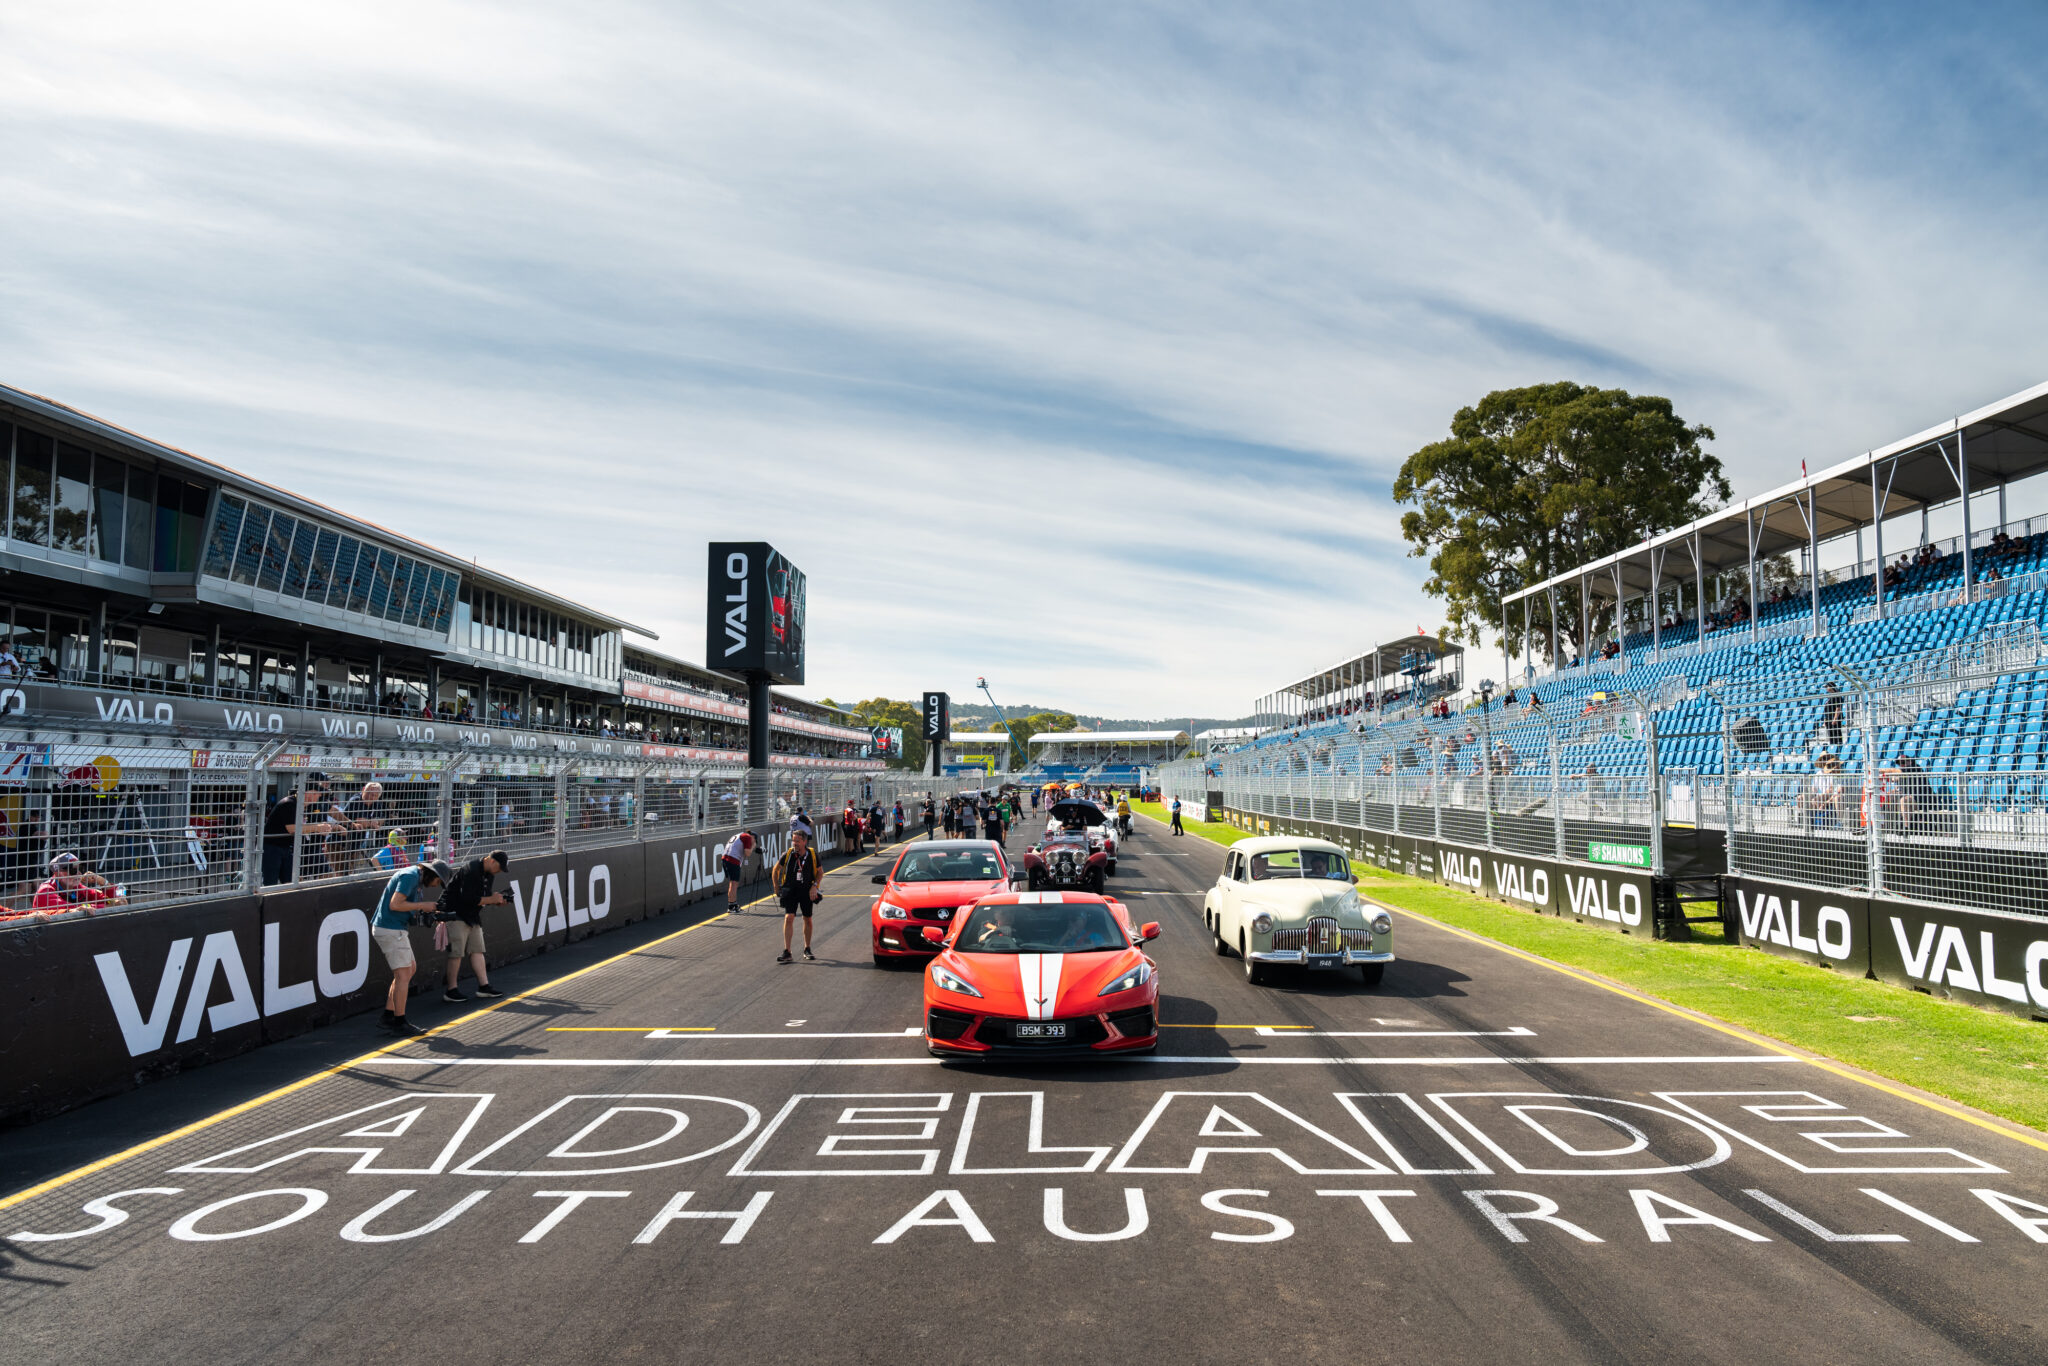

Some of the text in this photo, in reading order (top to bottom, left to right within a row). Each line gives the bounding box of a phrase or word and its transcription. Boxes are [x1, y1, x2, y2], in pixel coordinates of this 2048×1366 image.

[725, 552, 748, 657] VALO
[95, 696, 174, 726] VALO
[223, 708, 283, 733] VALO
[321, 717, 368, 739] VALO
[929, 695, 938, 735] VALO
[396, 724, 435, 743] VALO
[459, 729, 491, 748] VALO
[510, 734, 537, 749] VALO
[553, 738, 577, 751] VALO
[592, 742, 612, 754] VALO
[623, 743, 641, 755] VALO
[815, 822, 838, 853] VALO
[1602, 844, 1644, 865] SHANNONS
[672, 843, 726, 896] VALO
[1439, 850, 1482, 888] VALO
[1493, 860, 1549, 905] VALO
[510, 864, 611, 941] VALO
[1565, 873, 1642, 926] VALO
[1736, 889, 1851, 960] VALO
[93, 908, 370, 1058] VALO
[166, 1089, 2010, 1178] ADELAIDE
[5, 1186, 775, 1244] SOUTH
